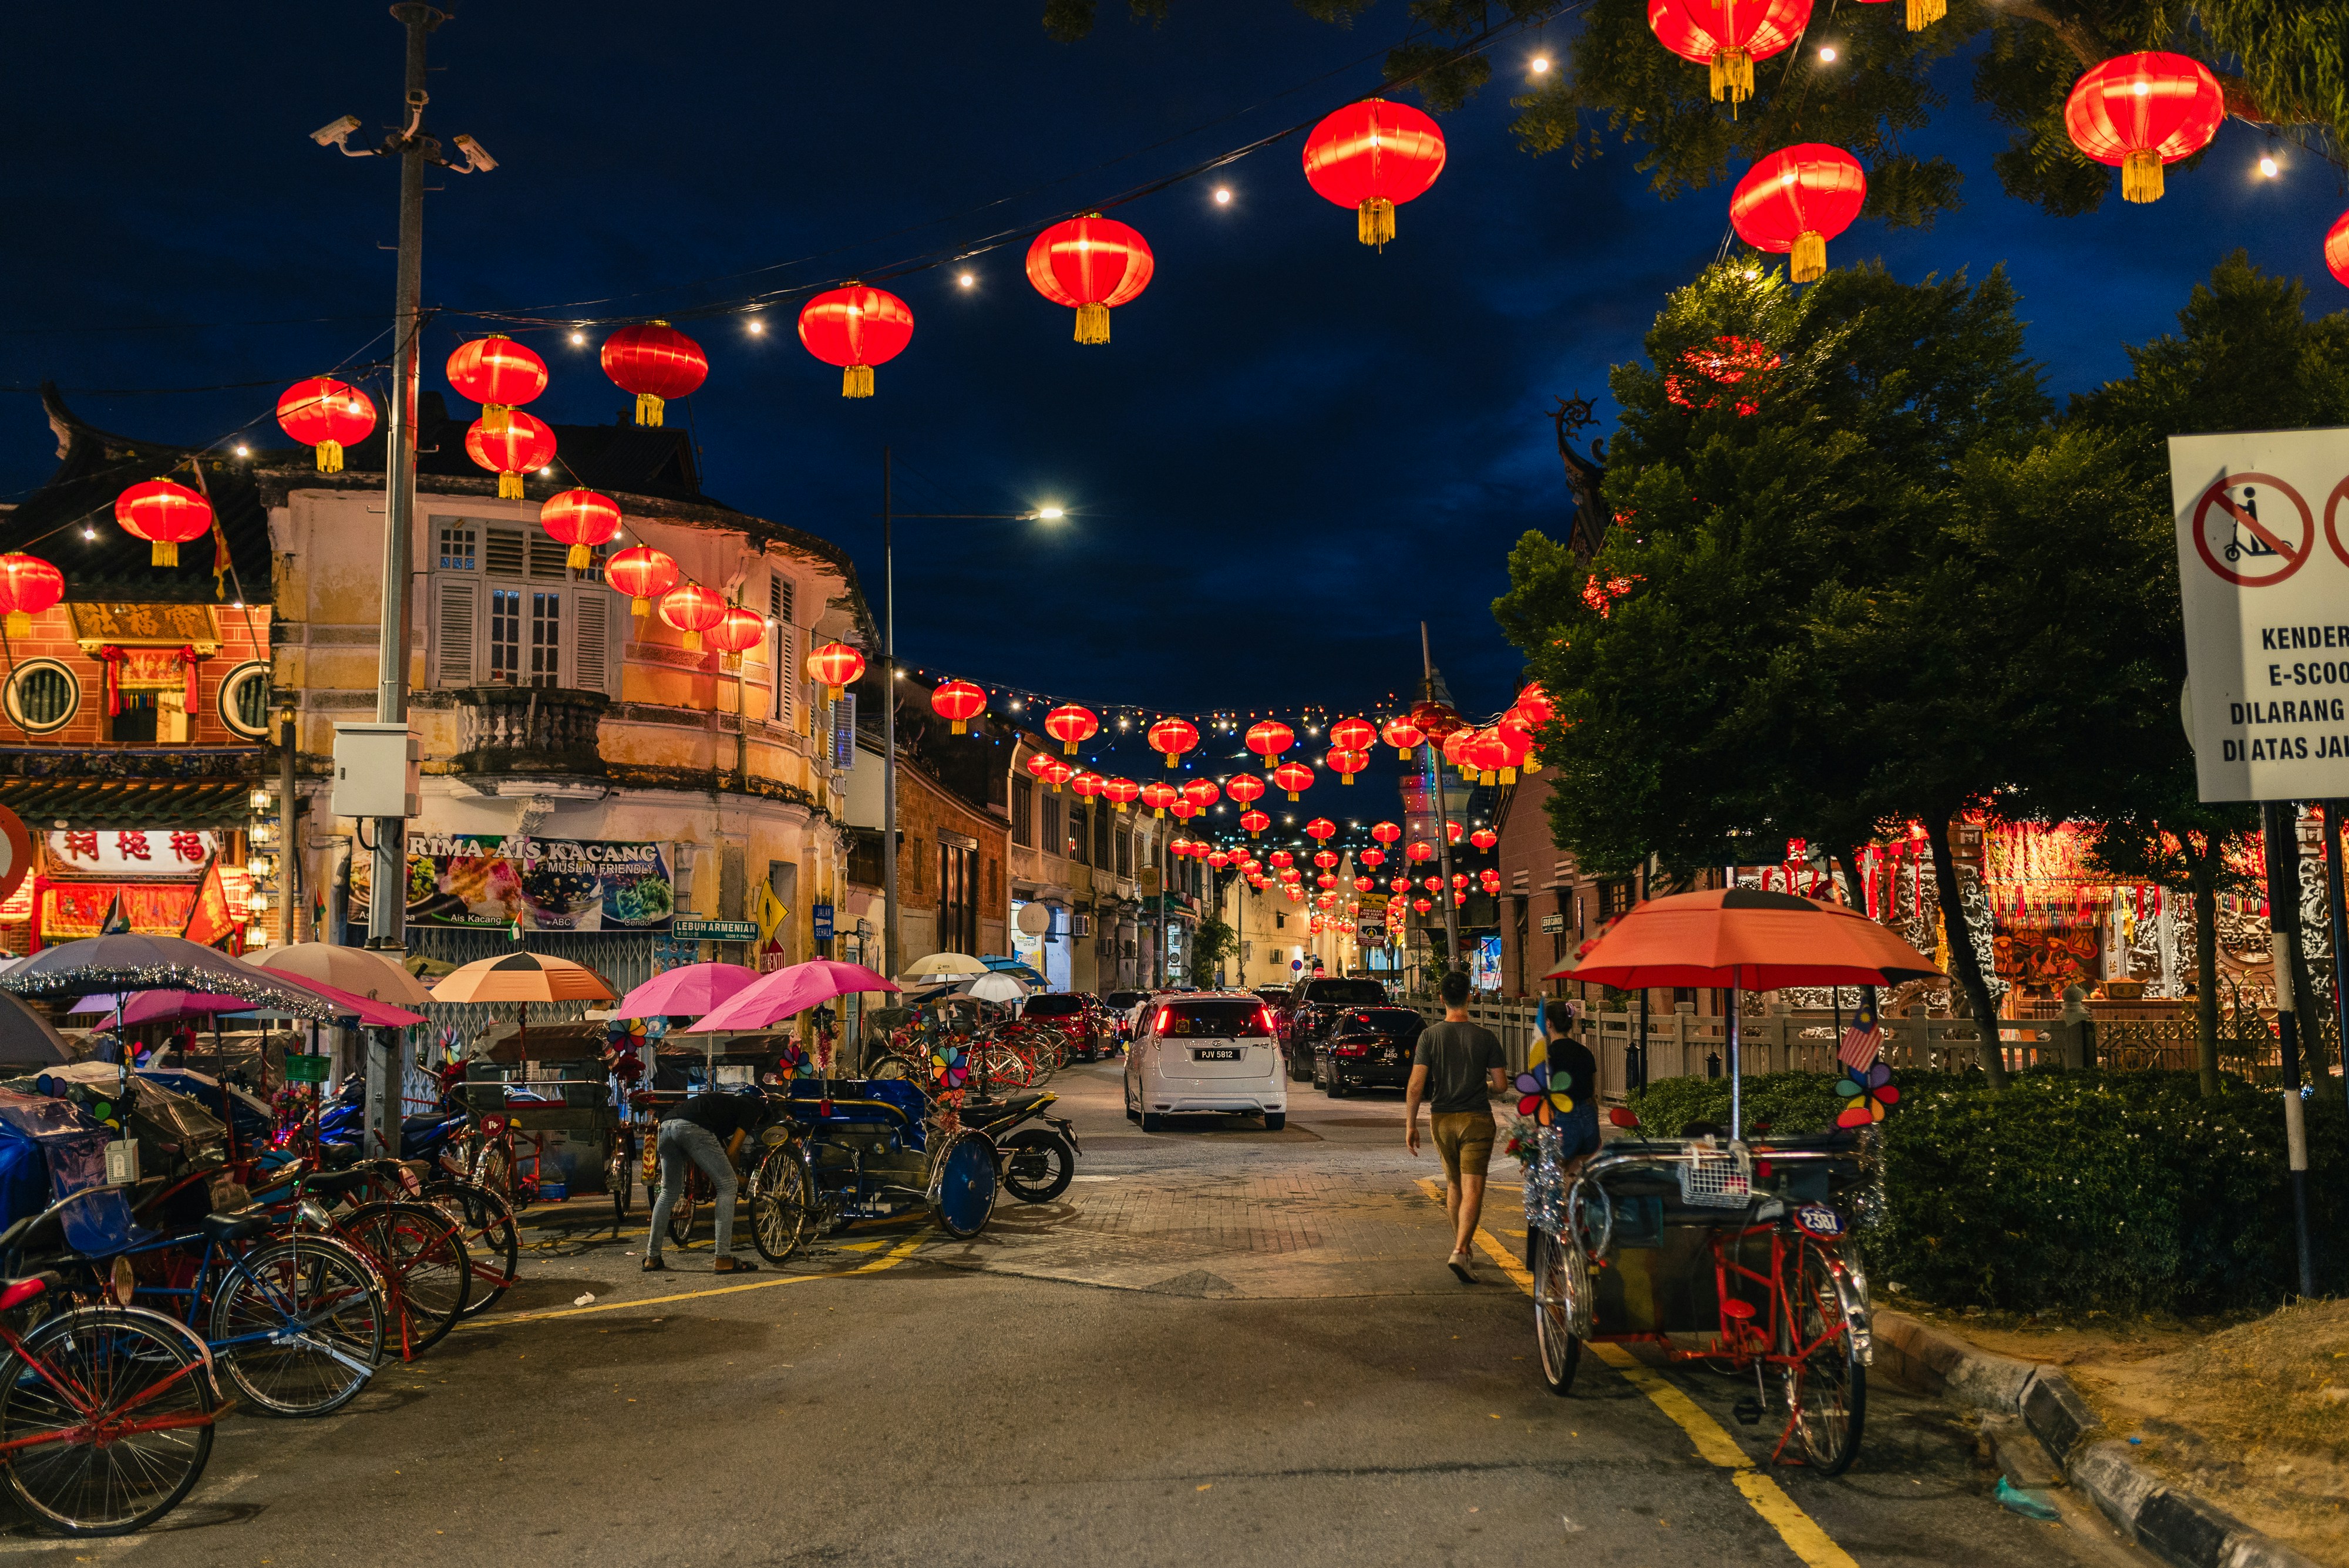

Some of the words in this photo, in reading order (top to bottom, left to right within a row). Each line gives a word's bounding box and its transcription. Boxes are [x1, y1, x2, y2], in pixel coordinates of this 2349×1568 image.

[2262, 625, 2349, 650] KENDER
[2269, 661, 2349, 687] E-SCOO
[2230, 698, 2344, 725] DILARANG
[2223, 739, 2245, 762] DI
[2252, 736, 2308, 761] ATAS
[493, 840, 541, 860] AIS
[546, 842, 658, 863] KACANG
[547, 862, 596, 874] MUSLIM
[599, 864, 655, 875] FRIENDLY
[450, 914, 465, 922] Ais
[467, 914, 502, 925] Kacang
[817, 908, 830, 917] JALAN
[552, 918, 571, 926] ABC
[624, 918, 652, 927] Cendol
[677, 921, 706, 931] LEBUH
[708, 923, 756, 933] ARMENIAN
[816, 927, 831, 937] SEHALA
[760, 952, 783, 973] BERHENTI
[1801, 1212, 1838, 1230] 2387
